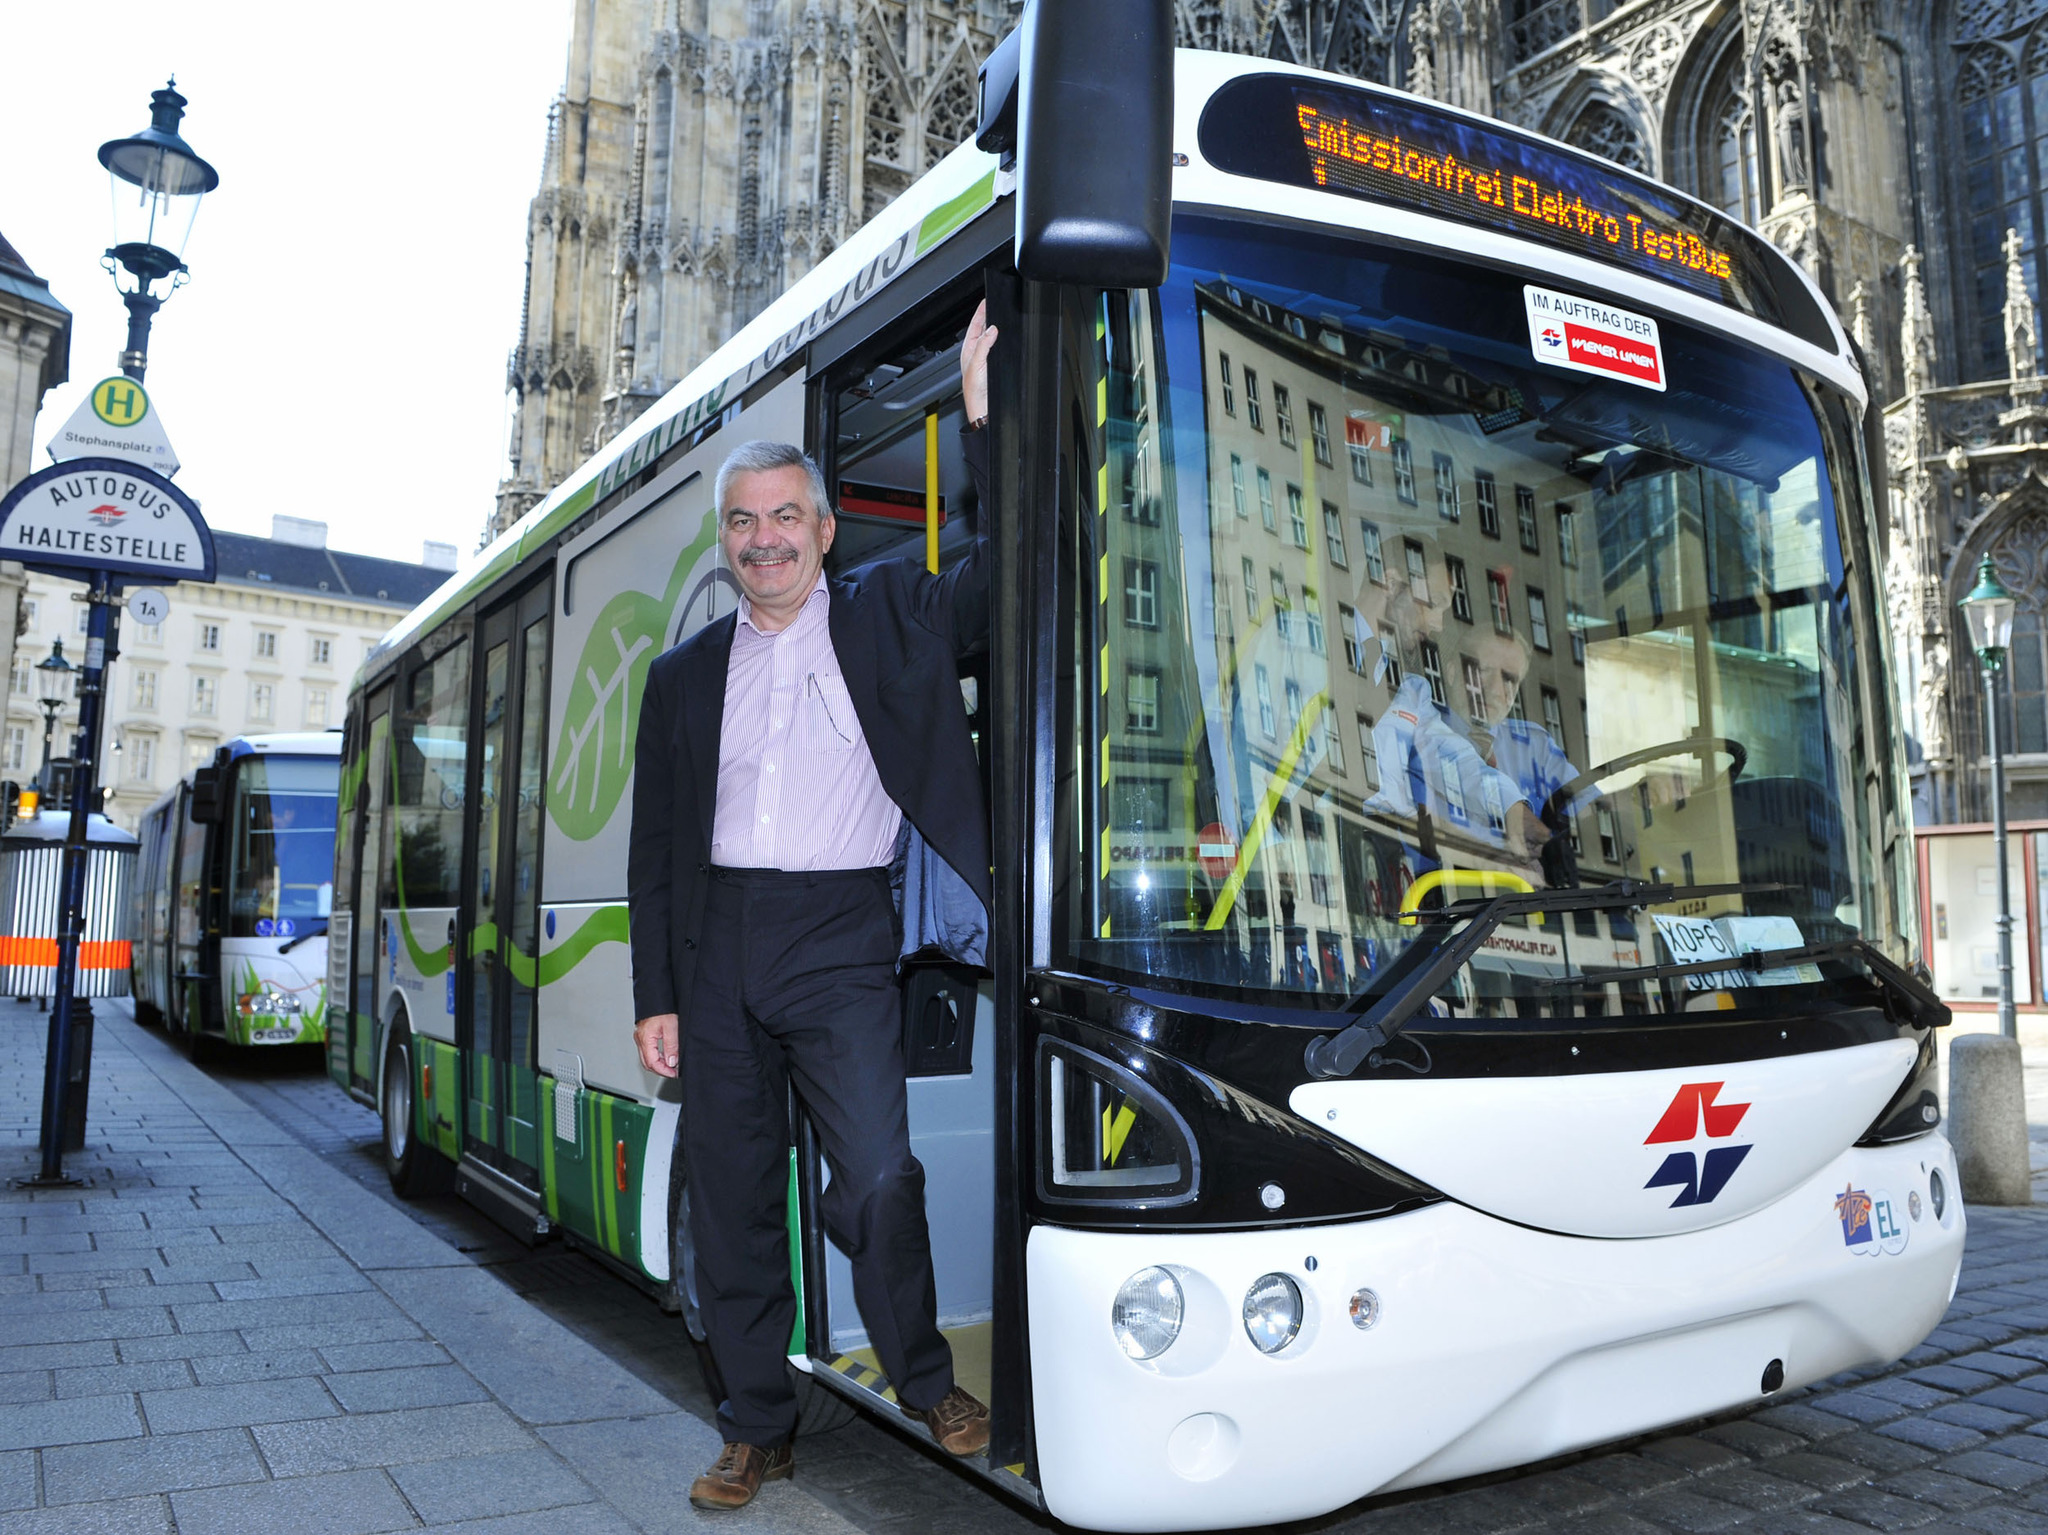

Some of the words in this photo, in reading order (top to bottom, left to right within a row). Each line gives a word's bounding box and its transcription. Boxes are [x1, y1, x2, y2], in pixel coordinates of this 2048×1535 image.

[1298, 103, 1505, 207] Emissionfrei
[1512, 175, 1620, 244] Elektro
[1532, 293, 1550, 310] IM
[1554, 298, 1622, 329] AUFTRAG
[1624, 317, 1652, 338] DER
[1571, 337, 1619, 360] WIENER
[1619, 349, 1656, 370] LINIEN
[105, 385, 135, 418] H
[65, 431, 153, 454] Stephansplatz
[50, 476, 171, 519] AUTOBUS
[19, 524, 187, 563] HALTESTELLE
[1875, 1200, 1901, 1239] EL
